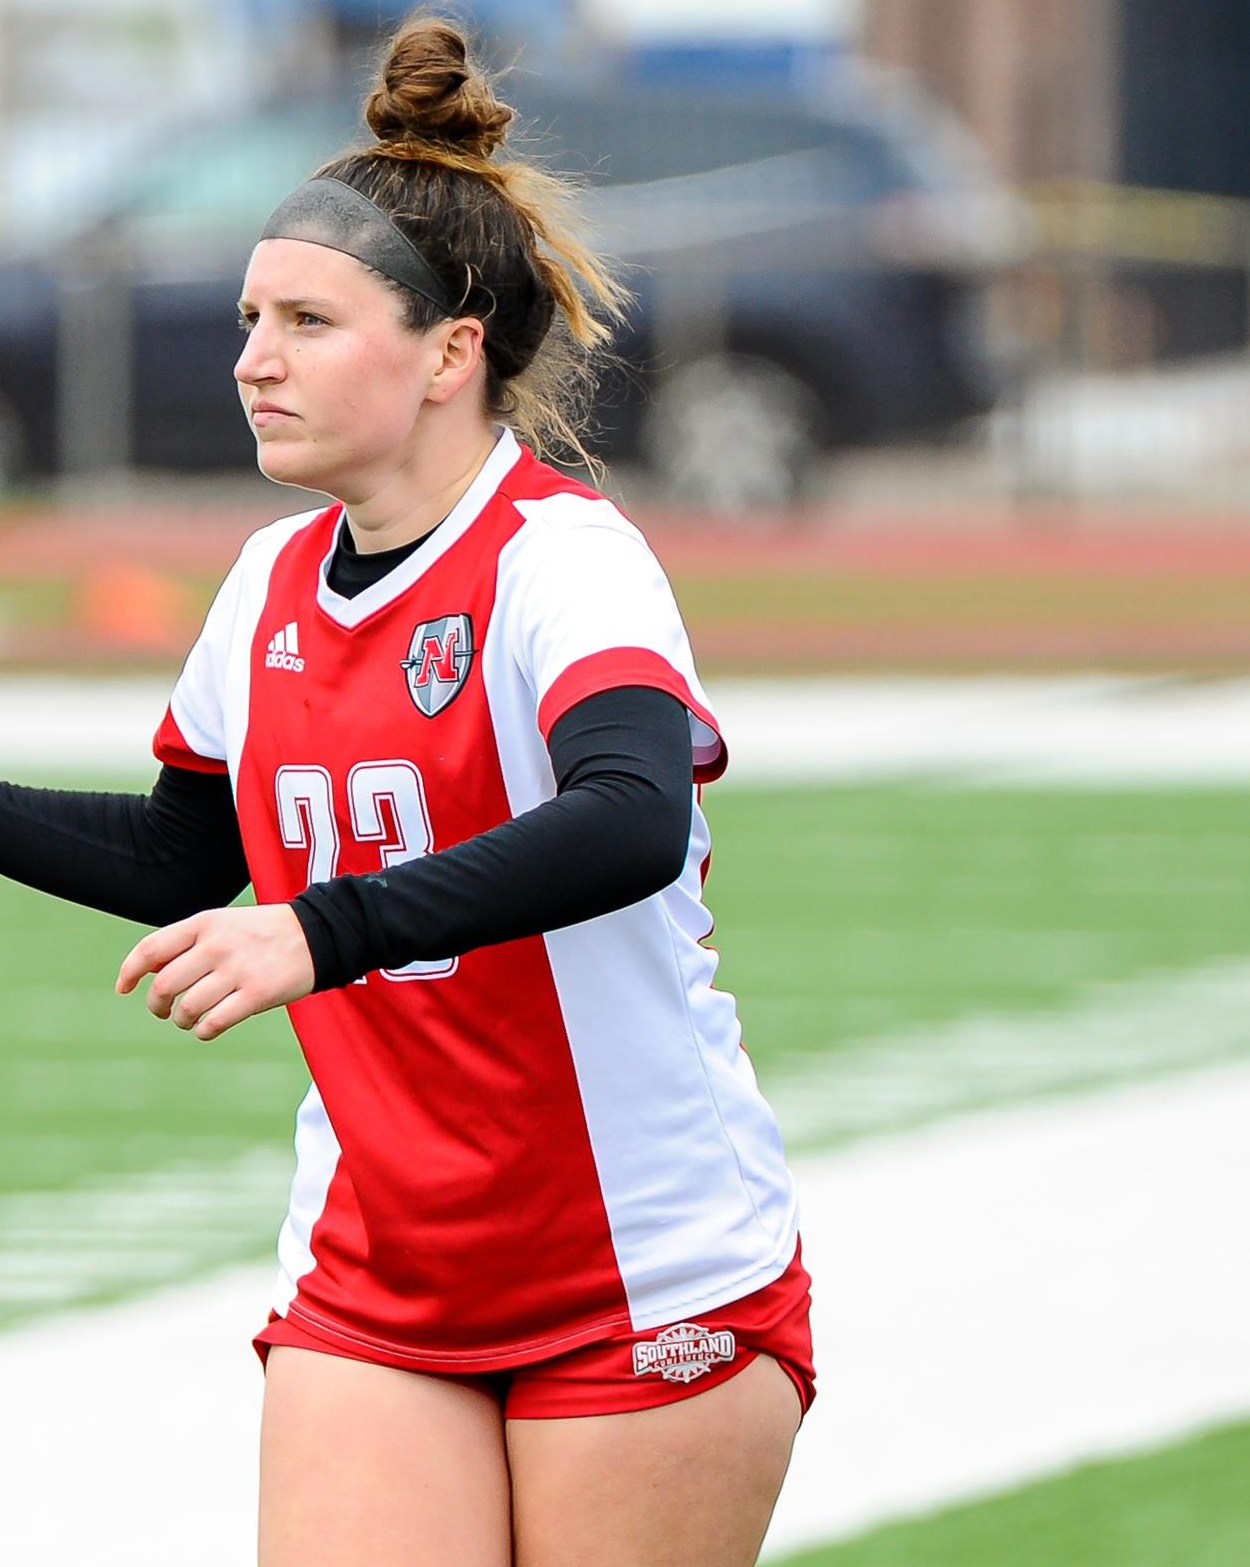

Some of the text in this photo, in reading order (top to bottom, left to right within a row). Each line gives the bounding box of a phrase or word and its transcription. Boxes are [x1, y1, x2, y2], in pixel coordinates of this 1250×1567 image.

[414, 629, 459, 687] N
[276, 759, 458, 983] 23
[636, 1335, 731, 1370] SOUTHLAND
